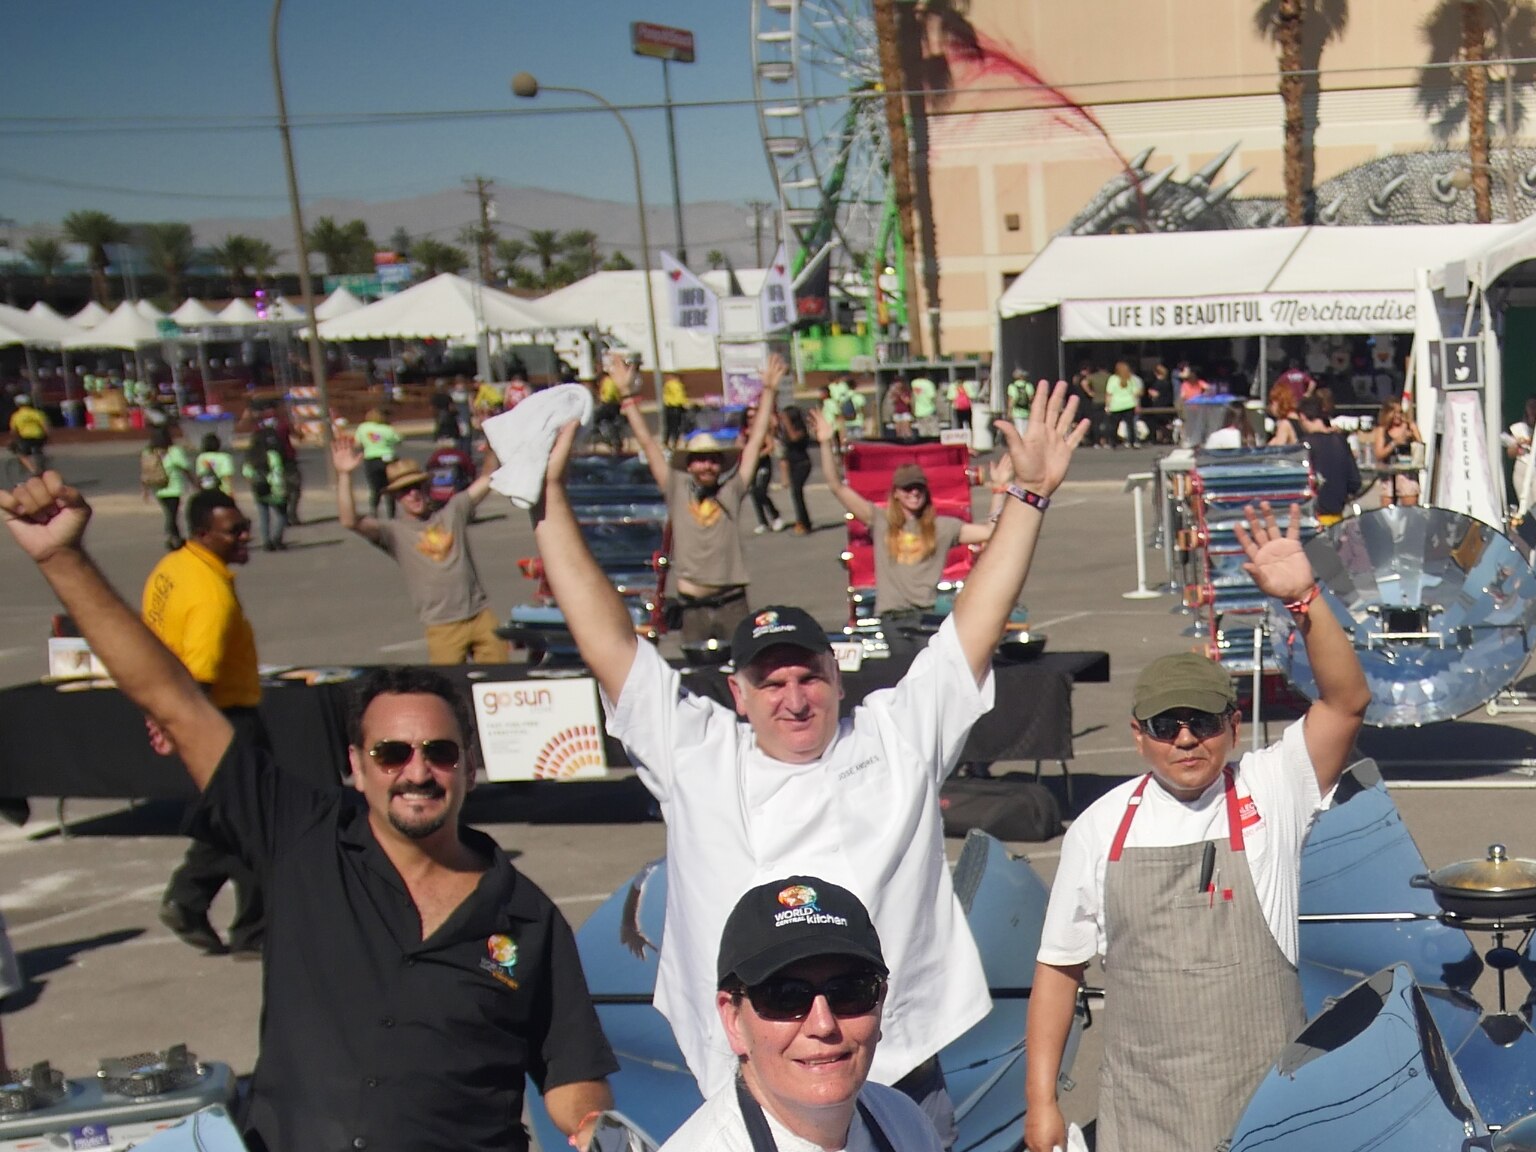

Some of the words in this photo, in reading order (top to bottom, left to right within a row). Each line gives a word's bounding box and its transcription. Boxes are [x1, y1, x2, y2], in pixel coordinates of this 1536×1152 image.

[1108, 306, 1141, 327] LIFE
[1150, 306, 1165, 326] IS
[1174, 301, 1262, 325] BEAUTIFUL
[1270, 300, 1416, 326] Merchandise
[1460, 412, 1471, 480] CHECK
[774, 907, 814, 921] WORLD
[775, 916, 806, 927] CENTRAL
[806, 914, 848, 927] kitchen
